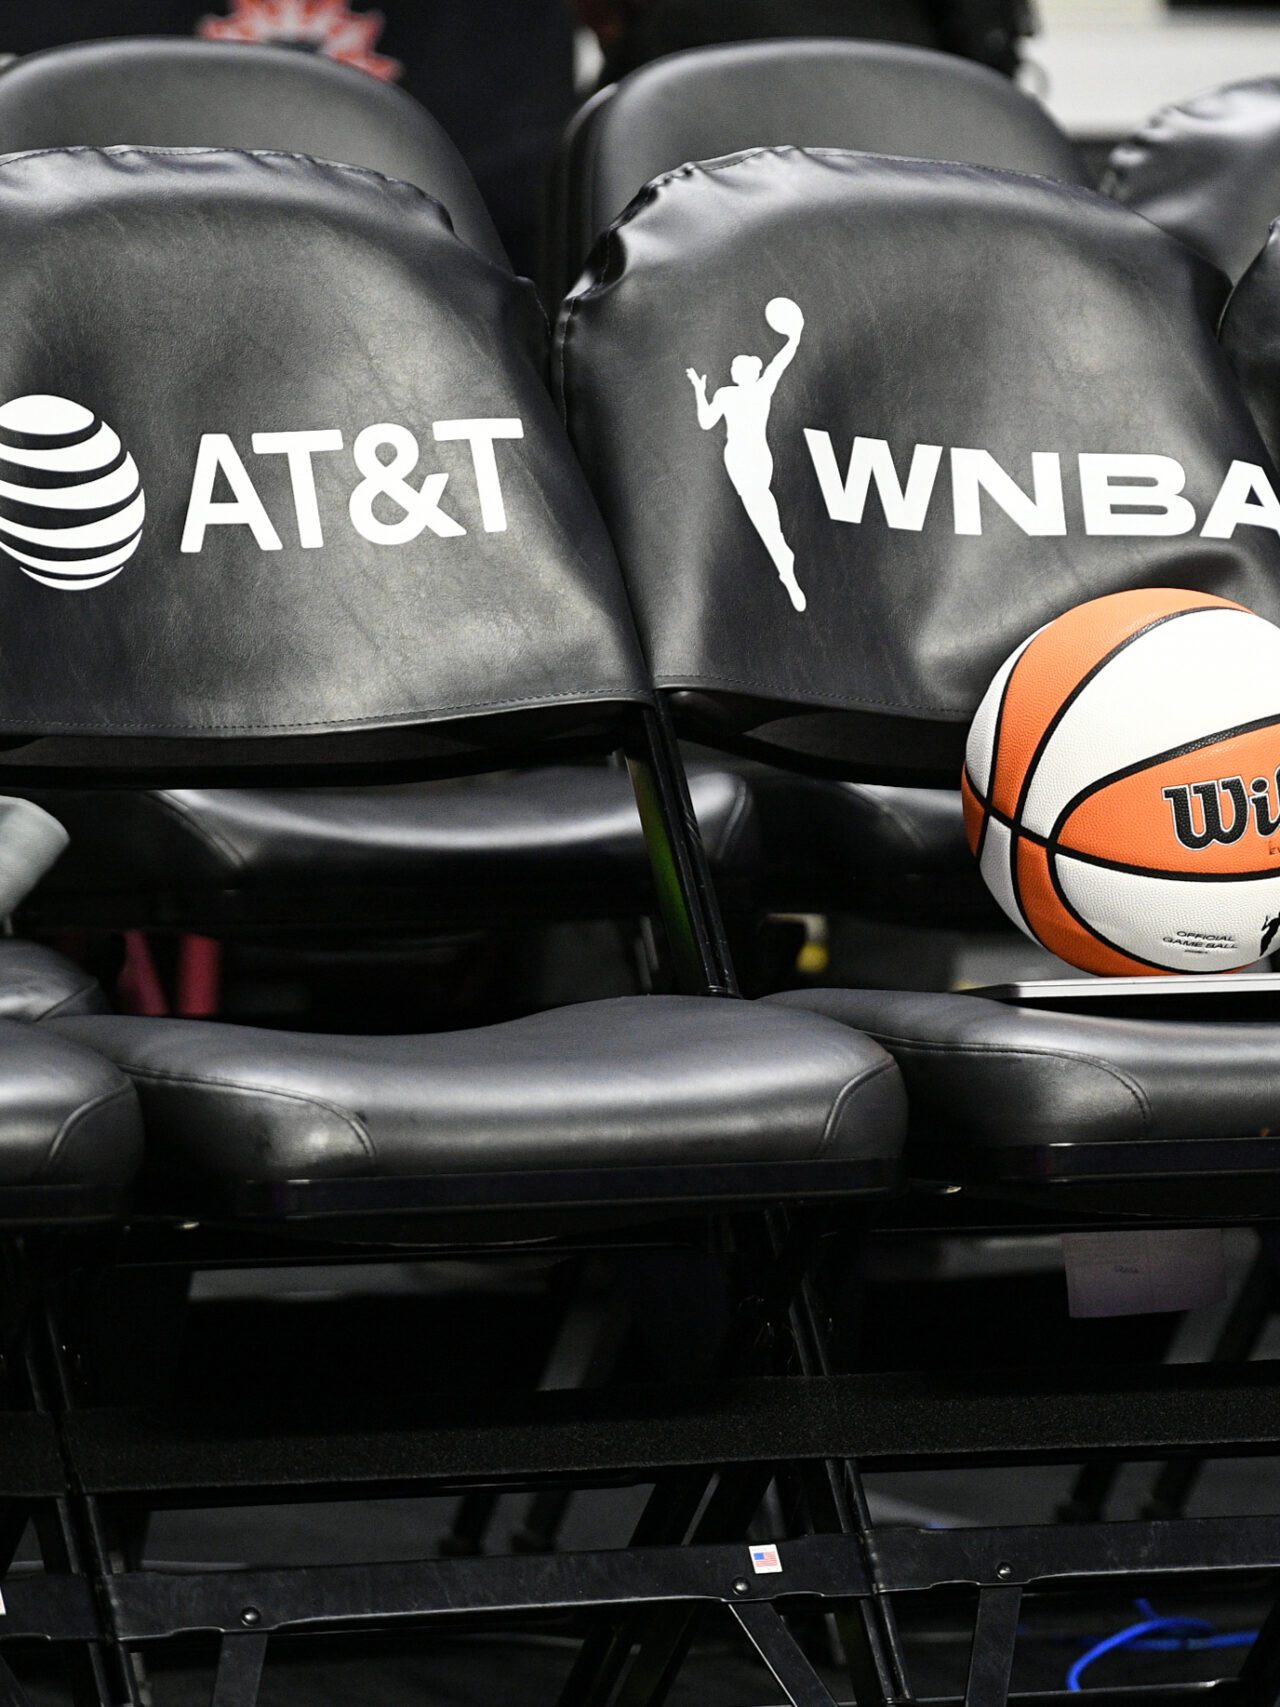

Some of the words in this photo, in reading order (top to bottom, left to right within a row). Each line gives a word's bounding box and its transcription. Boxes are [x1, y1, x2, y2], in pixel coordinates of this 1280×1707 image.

[180, 418, 524, 553] AT&T
[1162, 936, 1203, 948] GAME
[1205, 941, 1239, 949] BALL
[1176, 931, 1235, 942] OFFICIAL
